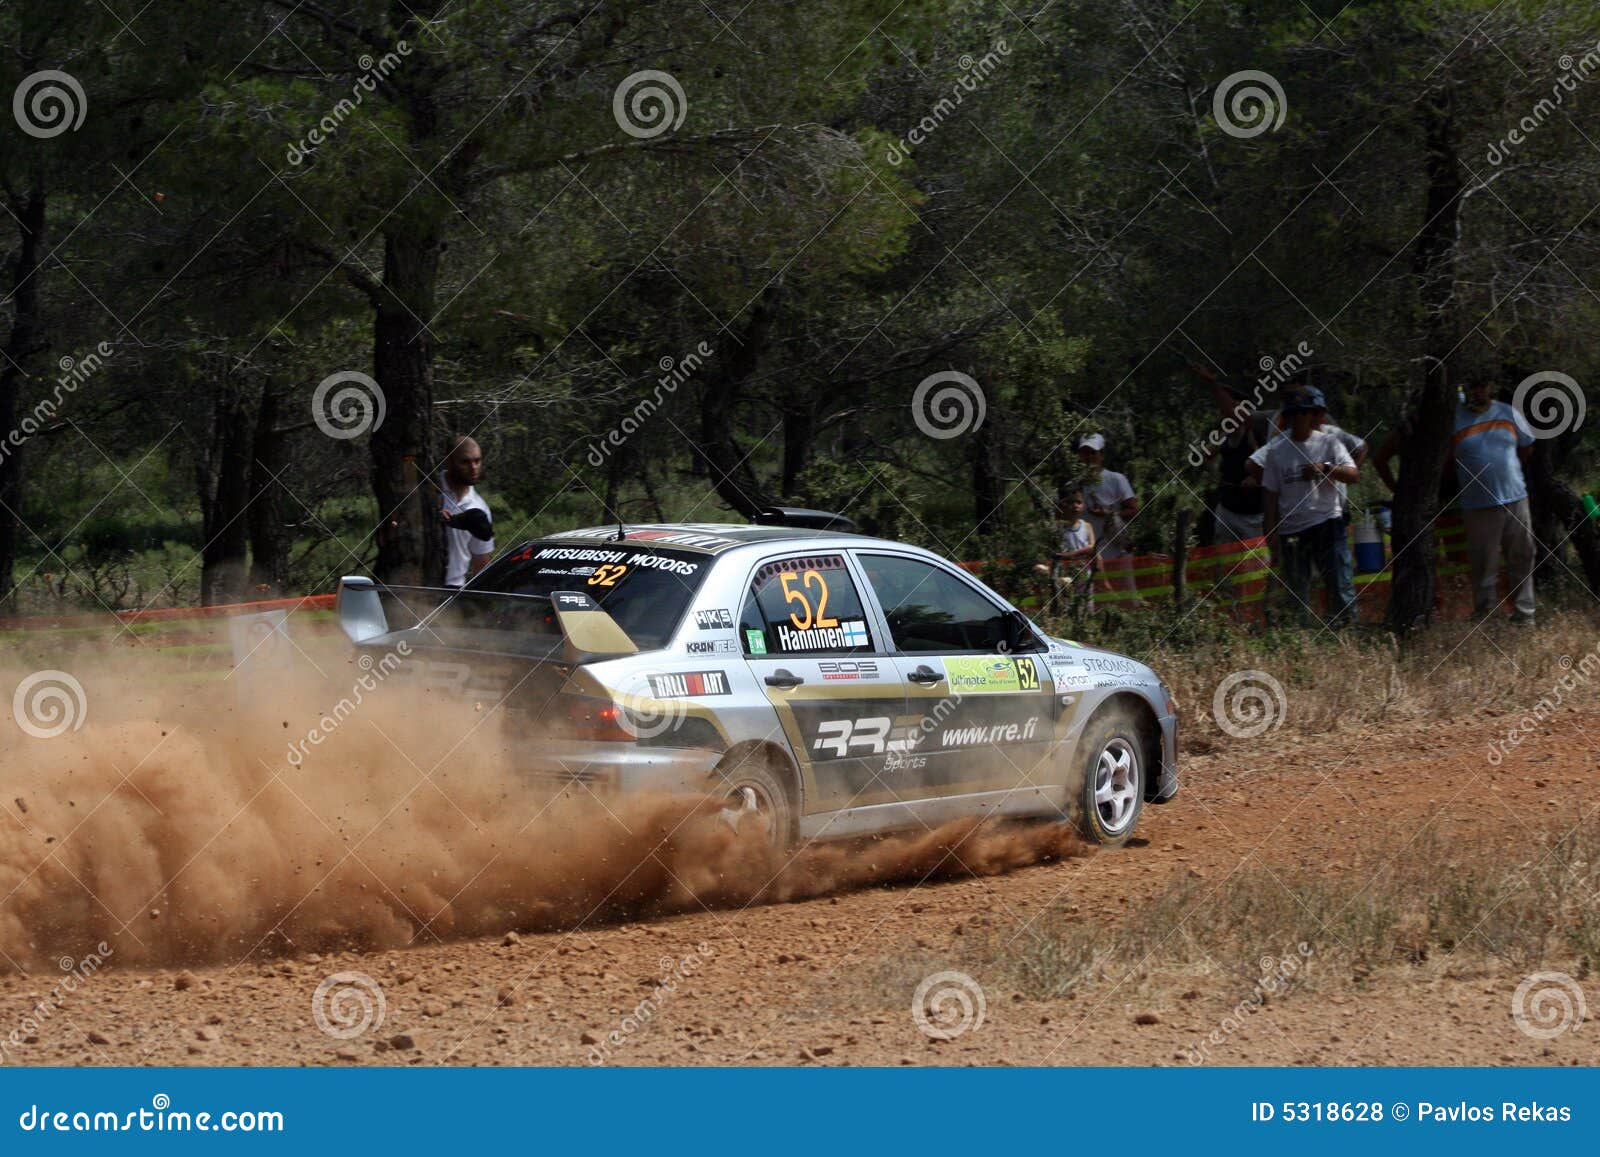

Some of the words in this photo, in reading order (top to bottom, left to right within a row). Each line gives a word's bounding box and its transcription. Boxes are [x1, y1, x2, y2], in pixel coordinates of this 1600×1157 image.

[534, 548, 625, 563] MITSUBISHI
[628, 553, 698, 575] MOTORS
[587, 564, 627, 586] 52
[780, 570, 838, 630] 52
[696, 609, 732, 625] HKS
[778, 623, 846, 650] Hanninen
[1017, 659, 1039, 689] 52
[942, 717, 1038, 746] www.rre.fi
